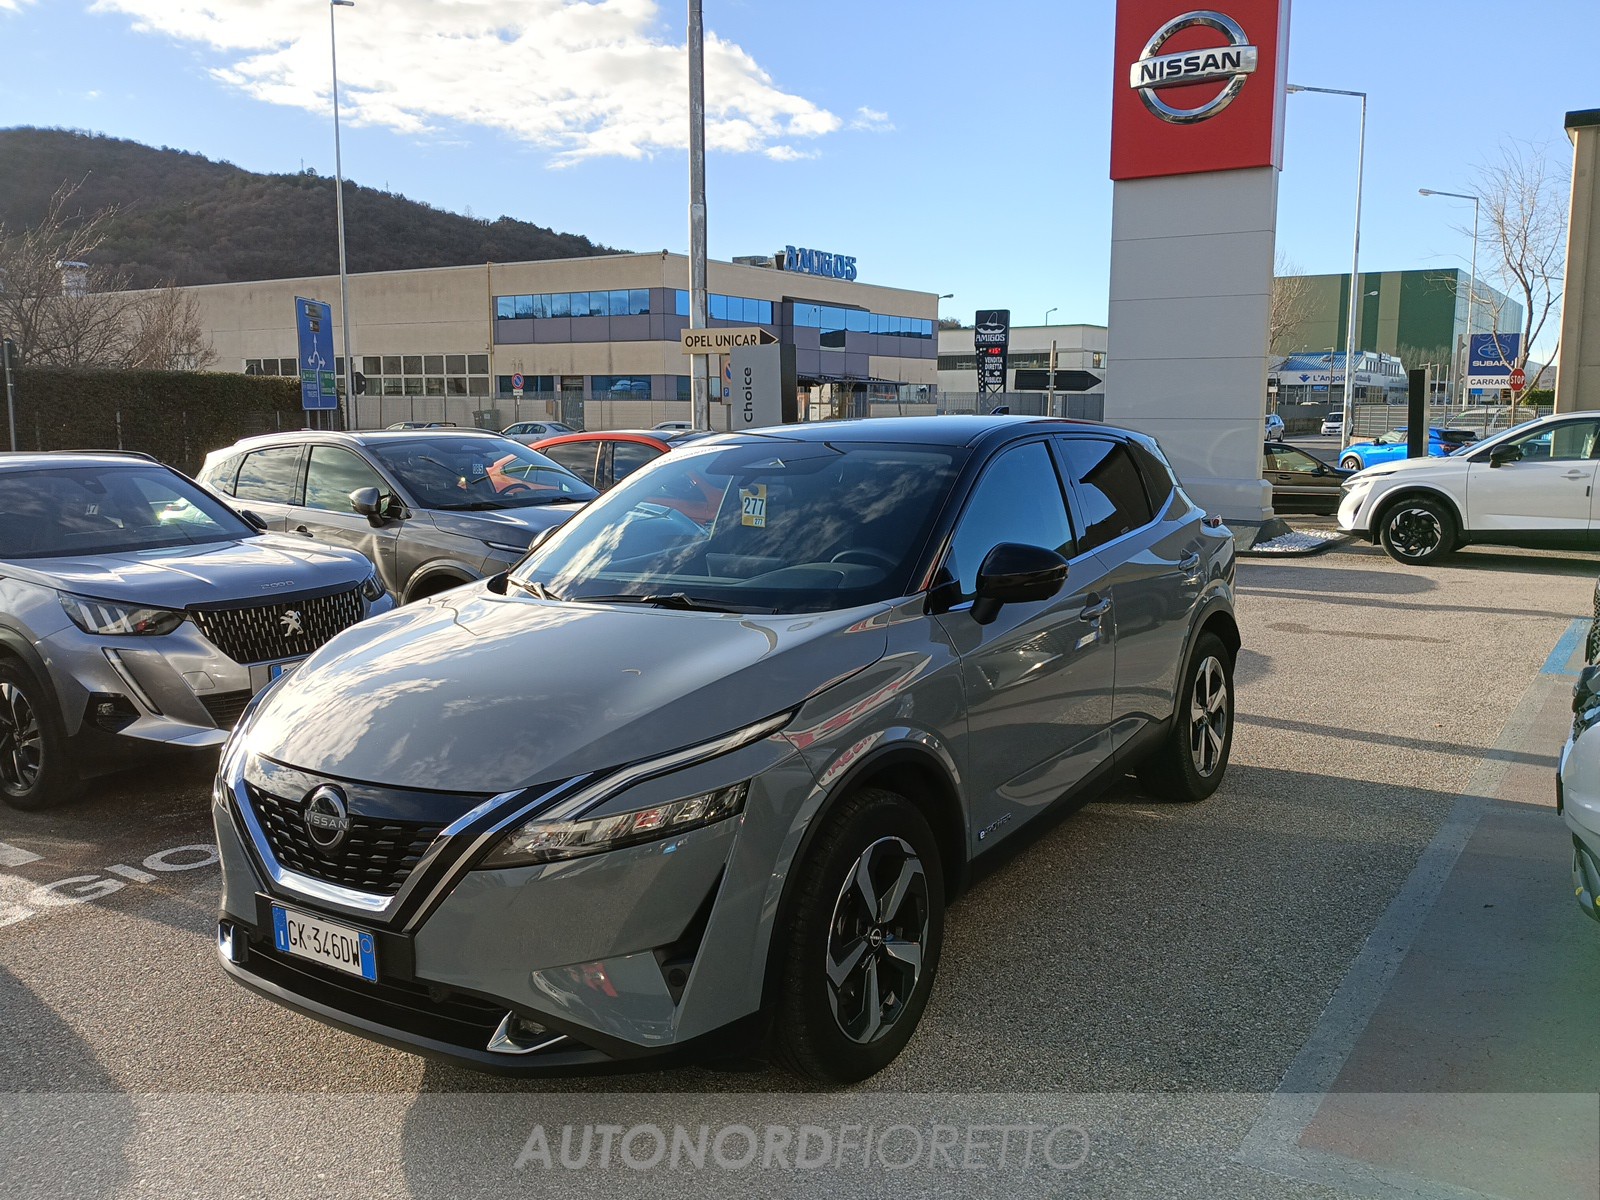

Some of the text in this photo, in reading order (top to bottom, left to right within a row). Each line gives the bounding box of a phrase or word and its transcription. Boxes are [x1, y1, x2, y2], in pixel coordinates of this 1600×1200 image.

[1141, 51, 1242, 82] NISSAN
[784, 245, 857, 281] AMIGOS
[685, 334, 757, 347] OPEL UNICAR
[975, 334, 1006, 342] AMIGOS
[1510, 375, 1525, 385] STOP
[743, 367, 753, 423] Choice
[744, 497, 764, 515] 277
[304, 810, 348, 829] NISSAN
[288, 920, 308, 950] GK
[312, 926, 360, 967] 346DW
